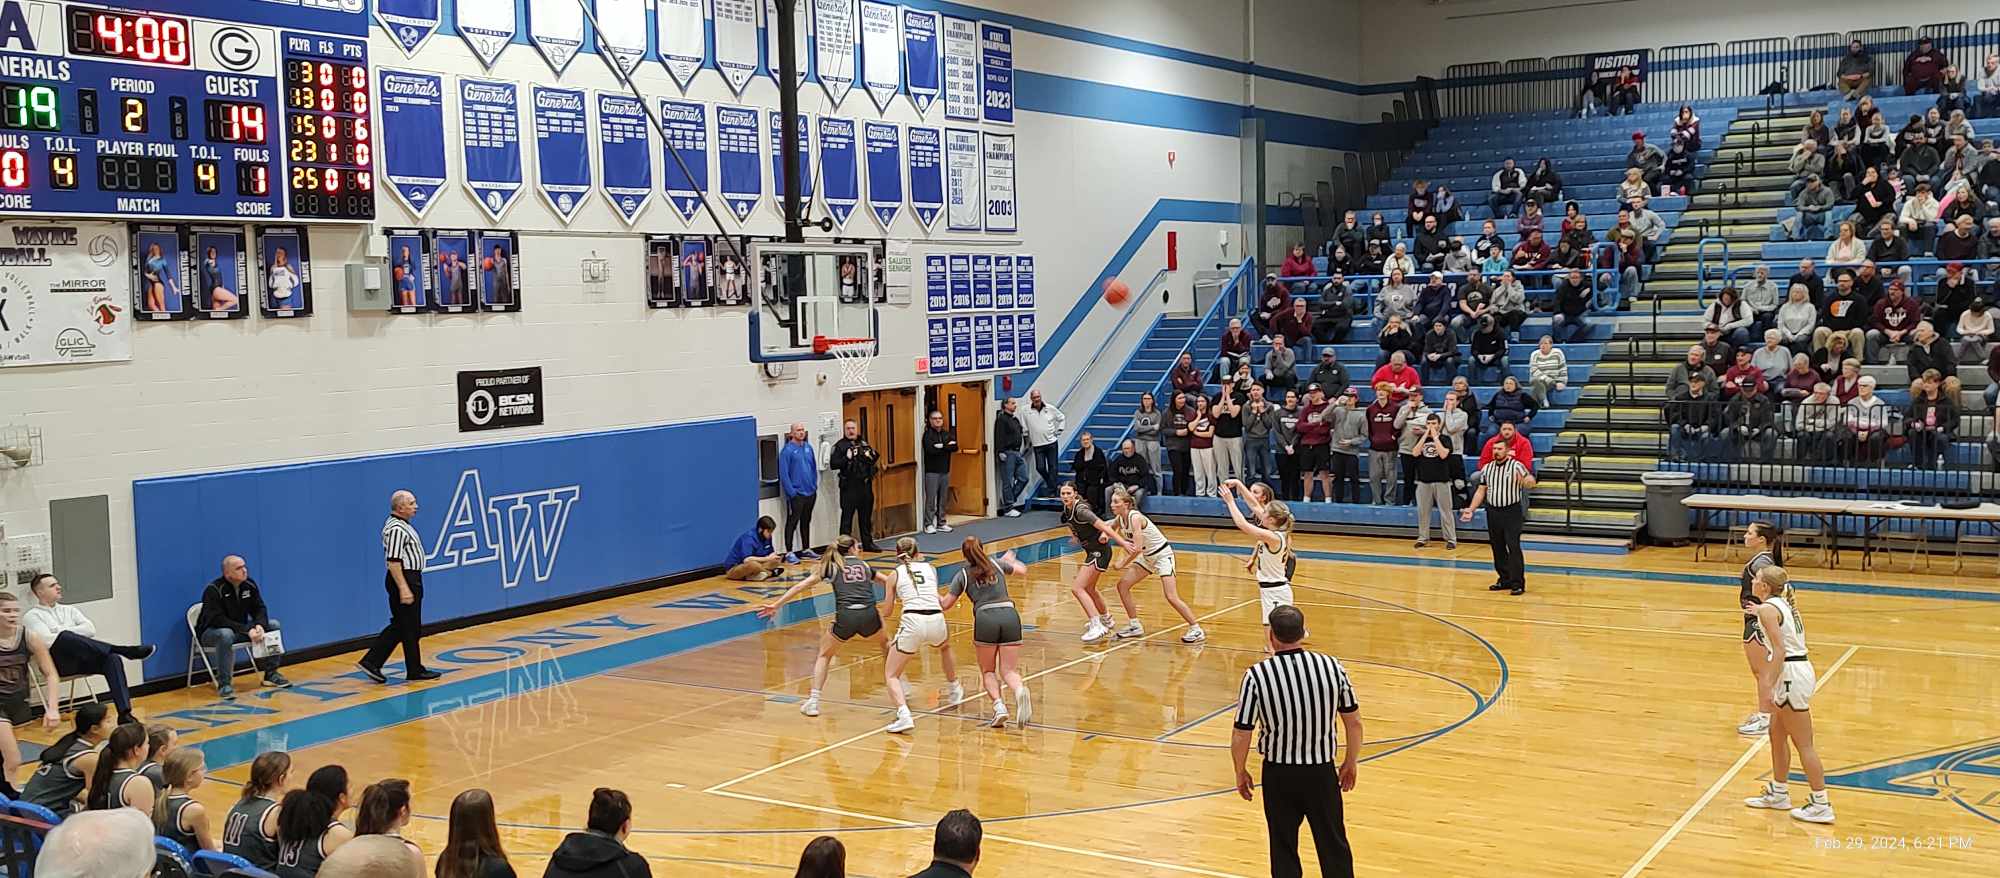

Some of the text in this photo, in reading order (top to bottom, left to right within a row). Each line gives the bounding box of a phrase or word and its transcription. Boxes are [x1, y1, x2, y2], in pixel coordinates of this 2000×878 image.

[97, 15, 187, 63] 4:00
[289, 37, 362, 57] PLYR FLS PTS
[1594, 54, 1640, 70] VISITOR
[319, 63, 333, 86] 0
[352, 67, 366, 89] 0
[111, 77, 155, 94] PERIOD
[205, 75, 259, 97] GUEST
[384, 75, 440, 97] Generals
[464, 84, 515, 105] Generals
[18, 87, 57, 128] 19
[295, 87, 367, 114] 13 0 0
[536, 91, 583, 111] Generals
[601, 98, 644, 116] Generals
[986, 90, 1010, 109] 2023
[125, 99, 144, 131] 2
[662, 104, 703, 122] Generals
[719, 109, 757, 128] Generals
[231, 105, 264, 142] 14
[296, 115, 368, 140] 15 0 6
[821, 120, 853, 137] Generals
[43, 137, 81, 152] T.O.L.
[97, 140, 179, 157] PLAYER FOUL
[189, 146, 221, 160] T.O.L.
[291, 139, 317, 161] 23
[355, 143, 370, 166] 0
[949, 144, 976, 153] CHAMPIONS
[234, 148, 270, 162] FOULS
[986, 152, 1013, 161] CHAMPIONS
[2, 151, 25, 187] 0
[53, 157, 74, 185] 4
[197, 164, 216, 191] 4
[292, 167, 371, 191] 25 0 4
[117, 198, 160, 212] MATCH
[236, 202, 272, 215] SCORE
[988, 200, 1012, 216] 2003
[888, 256, 912, 264] SALUTES
[889, 265, 912, 273] SENIORS
[62, 279, 106, 288] MIRROR
[929, 295, 946, 308] 2013
[476, 375, 530, 387] PROUD PARTNER OF
[498, 393, 534, 406] BCSN
[499, 405, 535, 417] NETWORK
[422, 469, 580, 588] AW
[843, 565, 866, 583] 23
[150, 614, 658, 737] NTHONY
[224, 812, 249, 847] 11
